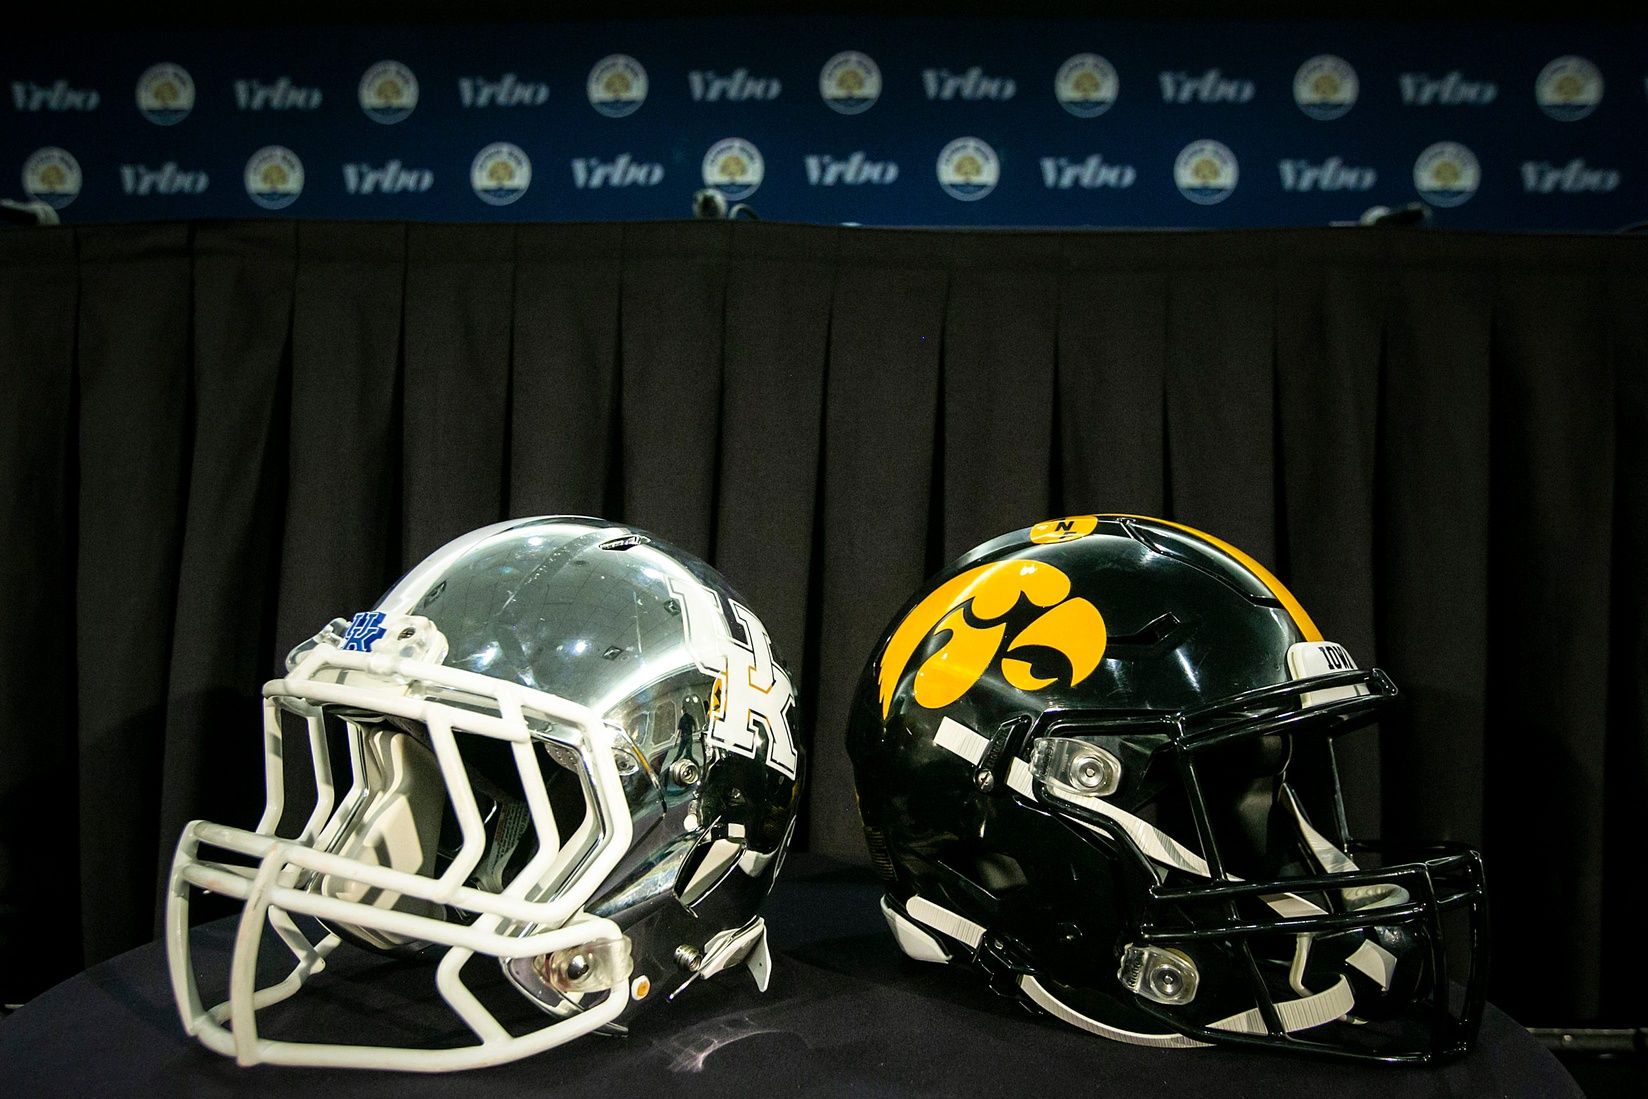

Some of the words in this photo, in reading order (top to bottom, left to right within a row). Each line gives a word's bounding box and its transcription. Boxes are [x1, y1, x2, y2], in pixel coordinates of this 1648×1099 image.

[11, 79, 100, 111] Vrbo
[235, 77, 322, 110] Vrbo
[459, 73, 549, 107] Vrbo
[689, 68, 781, 101] Vrbo
[923, 67, 1016, 100] Vrbo
[1159, 69, 1254, 103] Vrbo
[1400, 72, 1497, 104] Vrbo
[120, 162, 209, 195] Vrbo
[343, 159, 434, 195] Vrbo
[571, 153, 665, 189] Vrbo
[805, 151, 899, 186] Vrbo
[1040, 154, 1137, 189] Vrbo
[1279, 157, 1377, 192] Vrbo
[1521, 159, 1619, 193] Vrbo
